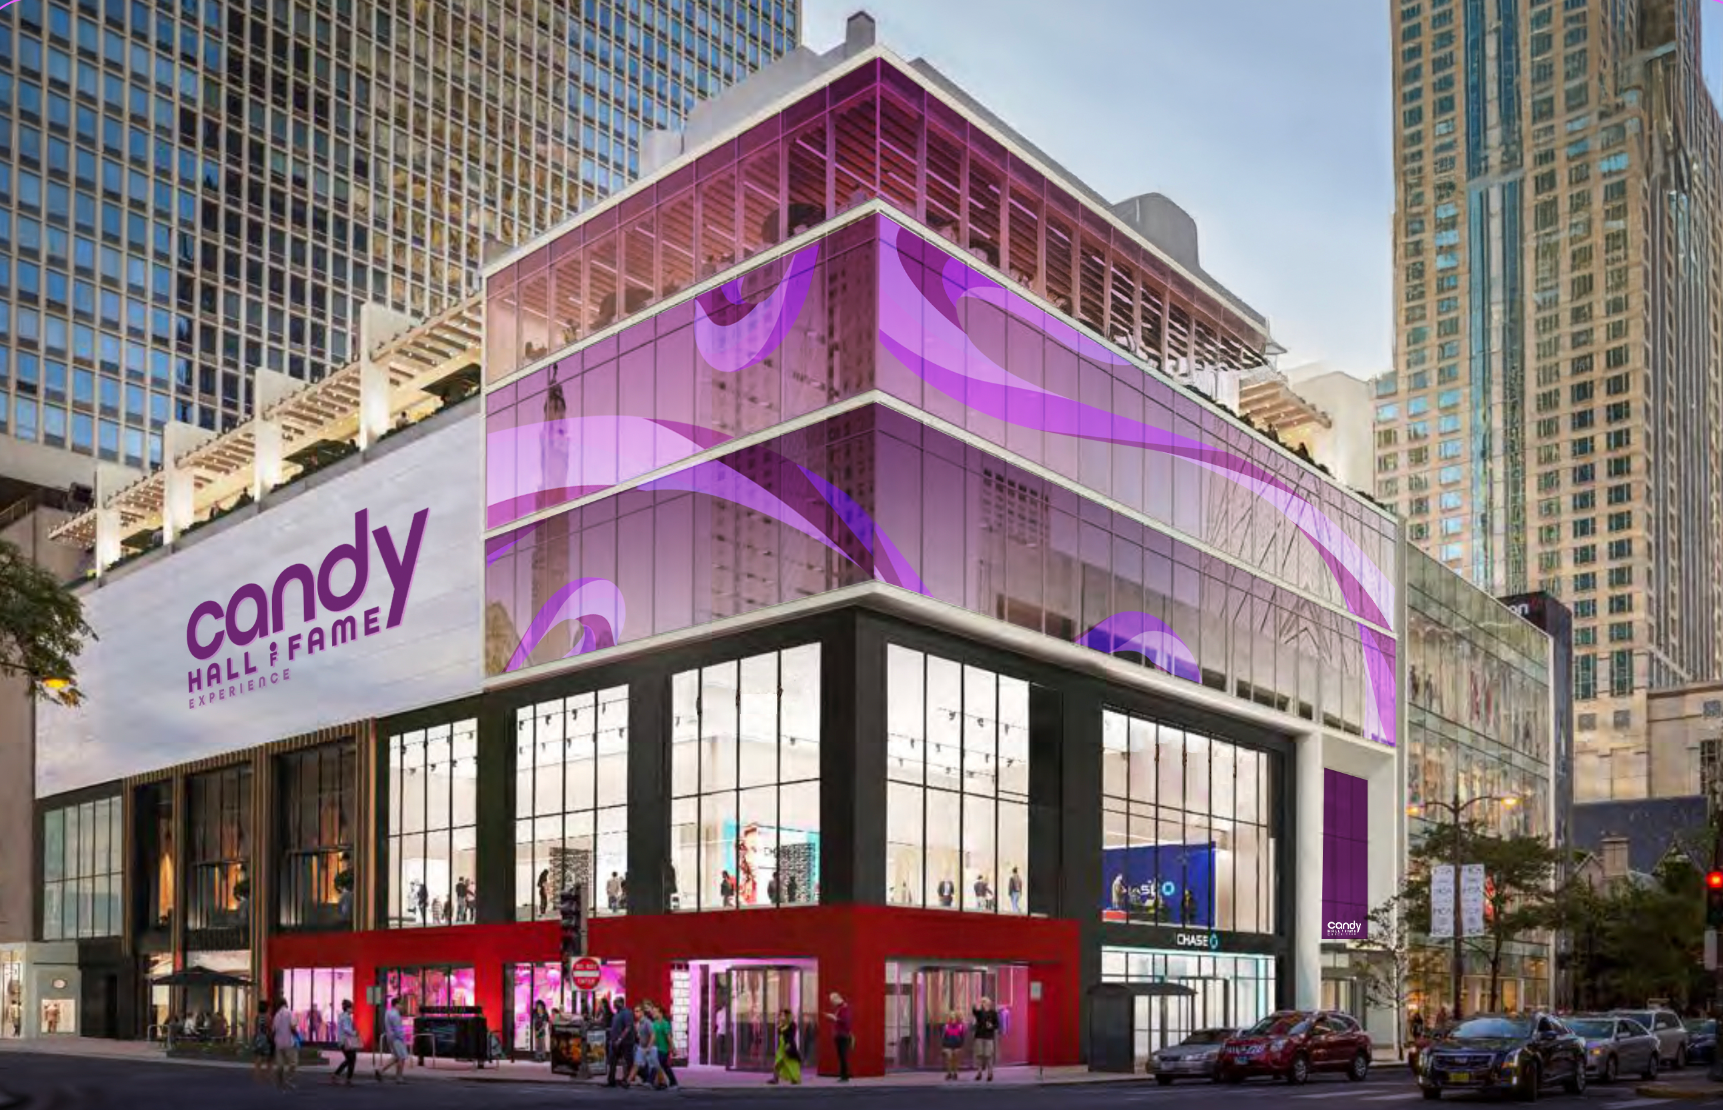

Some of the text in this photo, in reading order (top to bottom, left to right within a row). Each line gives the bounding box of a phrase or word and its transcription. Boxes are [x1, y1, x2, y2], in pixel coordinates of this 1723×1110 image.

[186, 507, 429, 661] candy
[188, 651, 258, 693] HALL
[287, 606, 381, 661] FAME
[188, 668, 291, 710] EXPERIENCE
[1176, 933, 1208, 947] CHASE
[1327, 920, 1362, 933] candy
